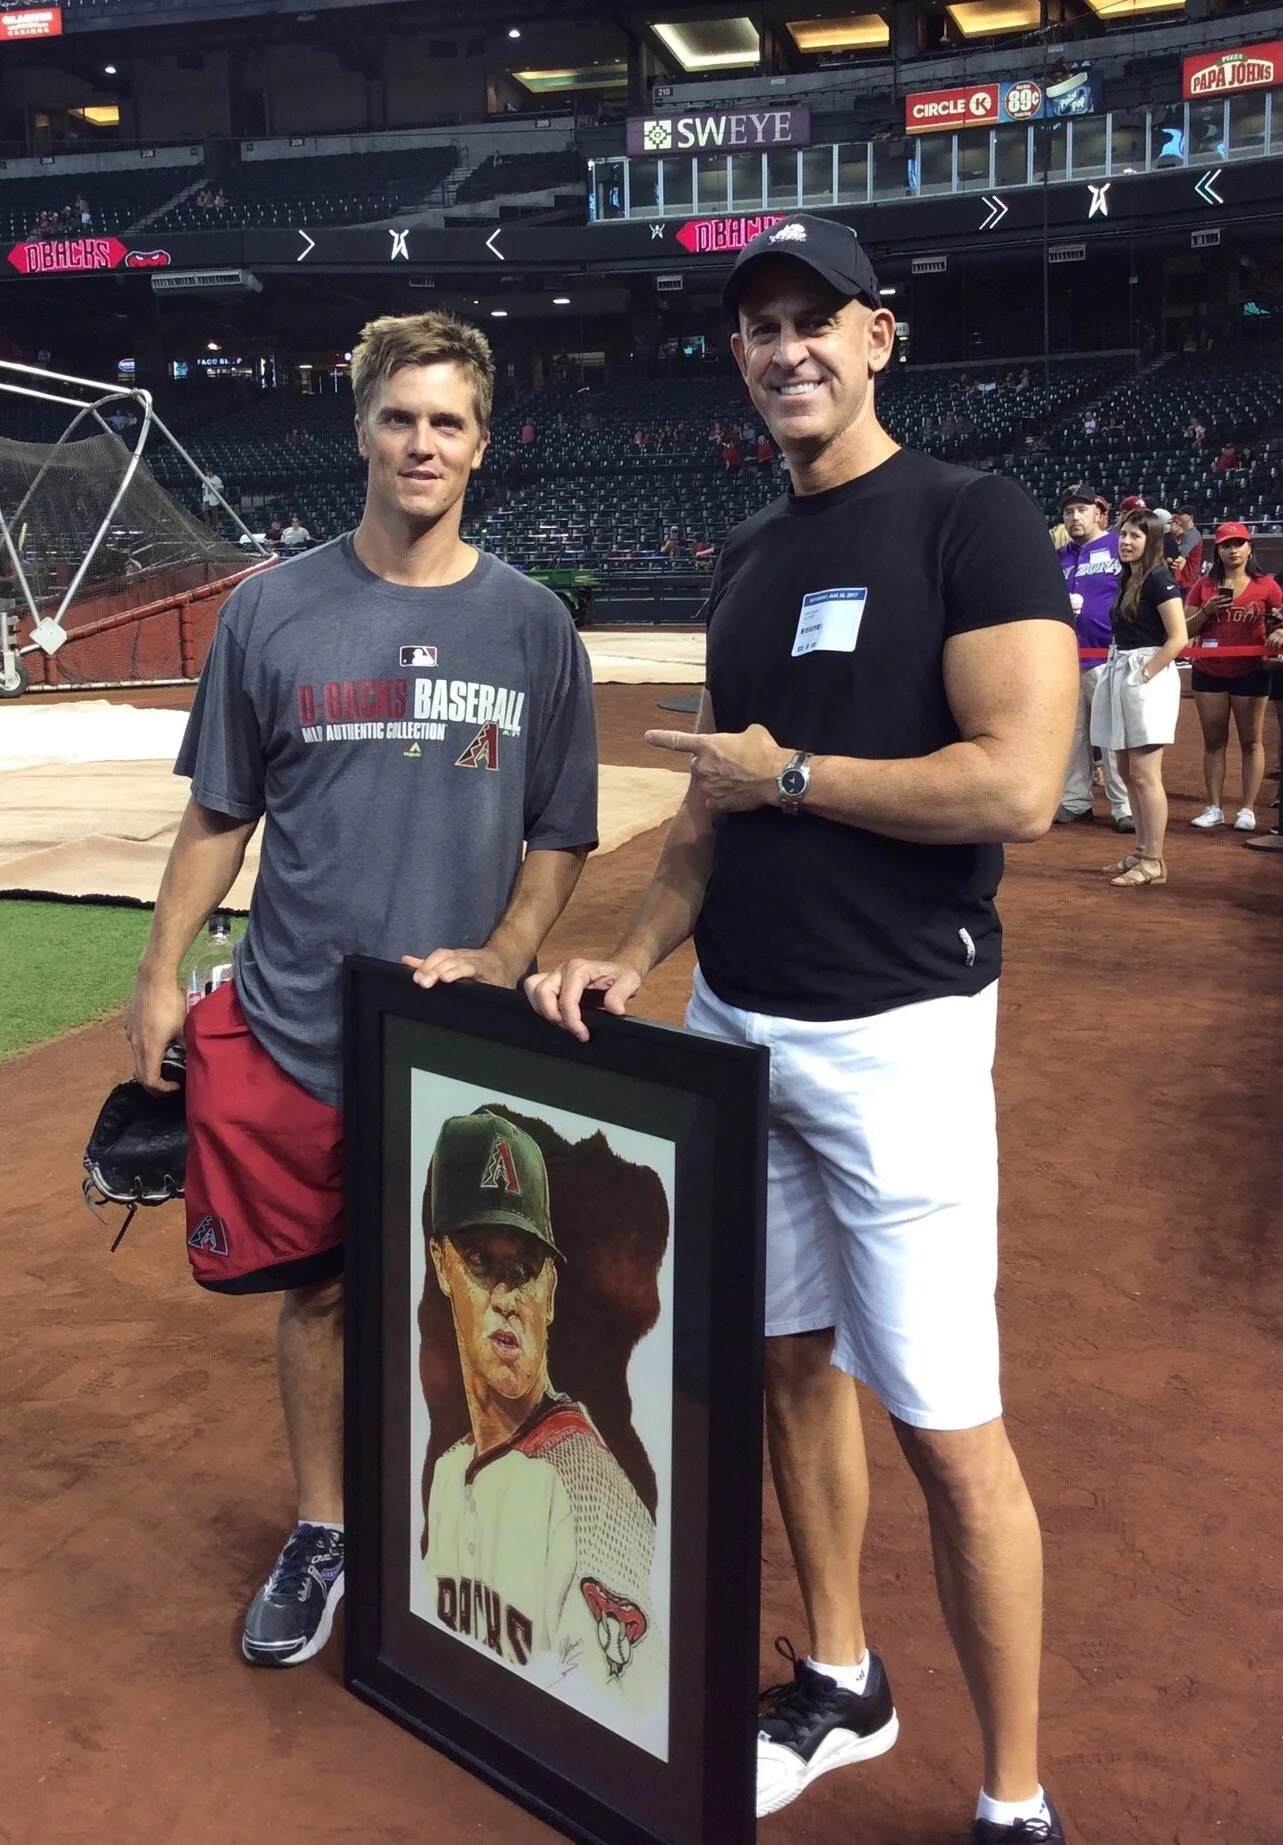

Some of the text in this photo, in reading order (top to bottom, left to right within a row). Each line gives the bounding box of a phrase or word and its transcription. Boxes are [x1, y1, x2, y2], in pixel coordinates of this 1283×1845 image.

[1222, 53, 1244, 62] PIZZA
[1193, 62, 1272, 91] PAPA JOHNS
[657, 88, 671, 96] 210
[912, 99, 966, 119] CIRCLE
[695, 216, 782, 252] DBAC
[24, 238, 111, 273] DBACKS
[297, 678, 525, 732] D-BACKS BASEBALL
[326, 722, 385, 741] AUTHENTIC
[386, 722, 446, 741] COLLECTION
